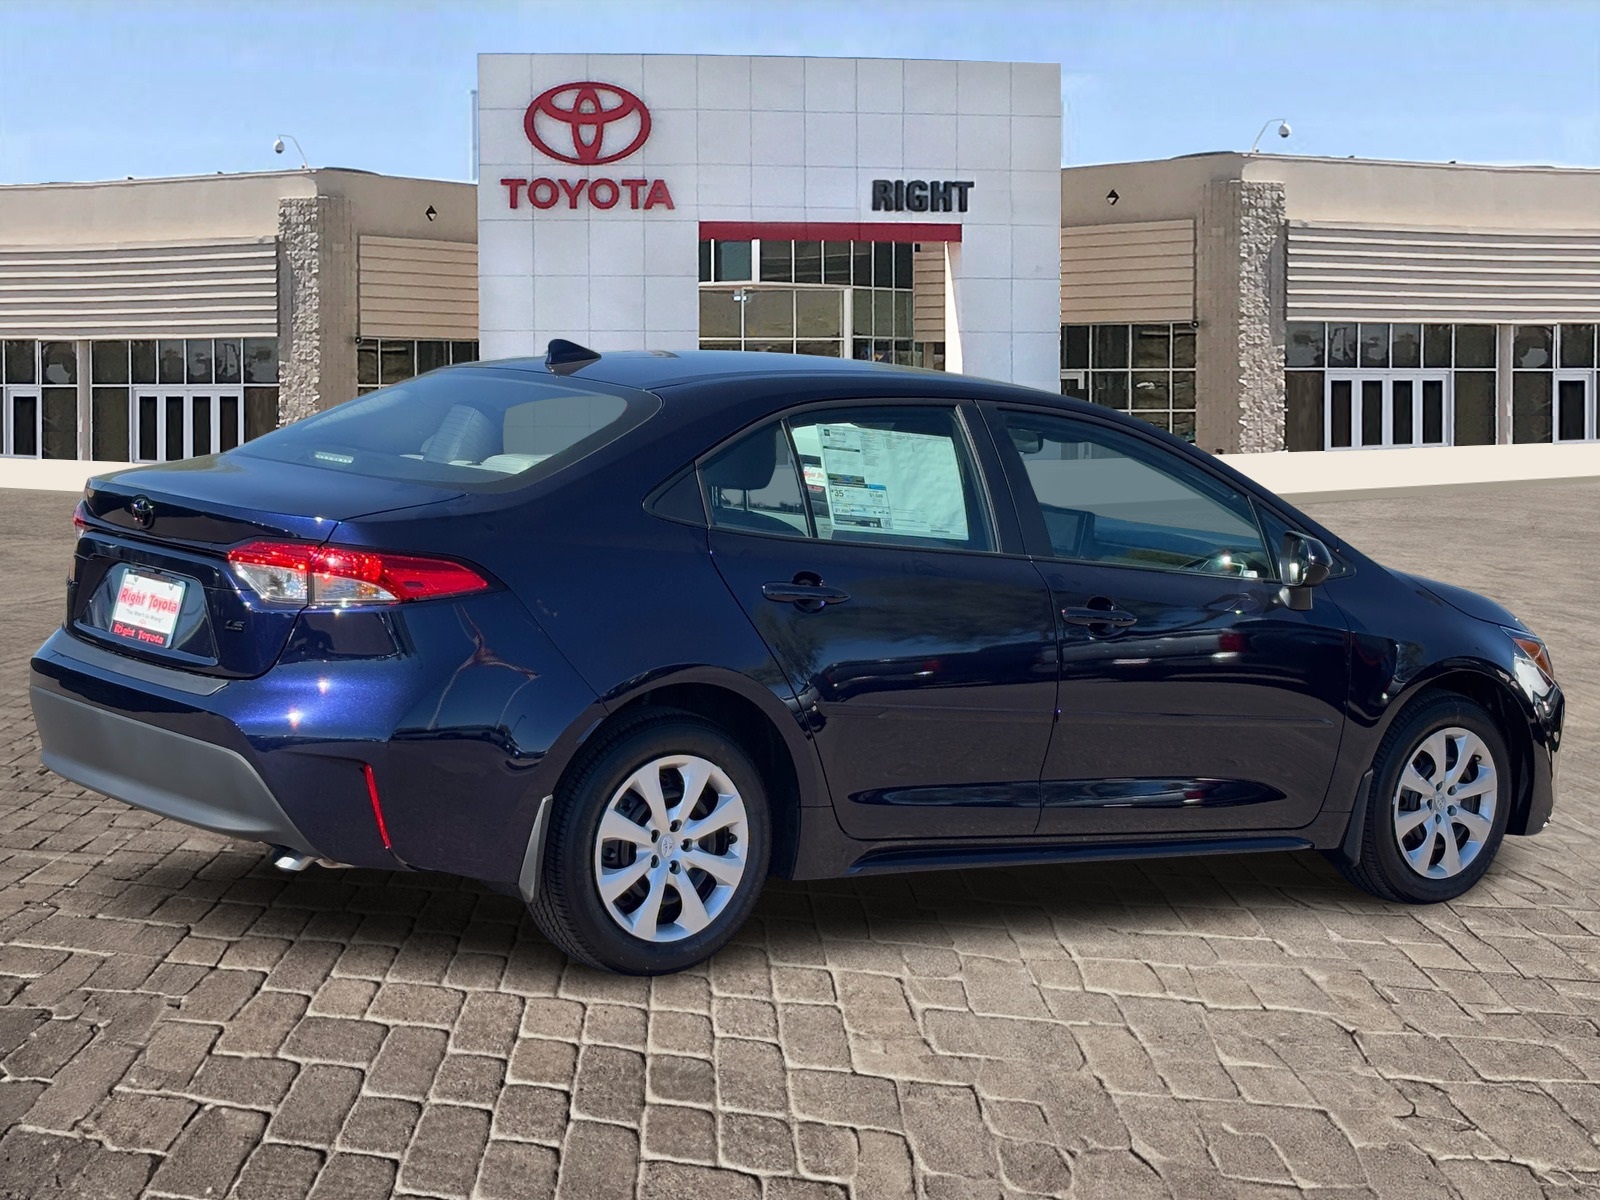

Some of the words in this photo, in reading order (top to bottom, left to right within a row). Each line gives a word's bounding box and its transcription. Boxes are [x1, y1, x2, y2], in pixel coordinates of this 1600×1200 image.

[500, 178, 675, 210] TOYOTA
[872, 179, 975, 212] RIGHT
[120, 587, 146, 606] Right
[148, 594, 178, 613] Toyota
[114, 624, 135, 637] Right
[138, 630, 164, 644] Toyota
